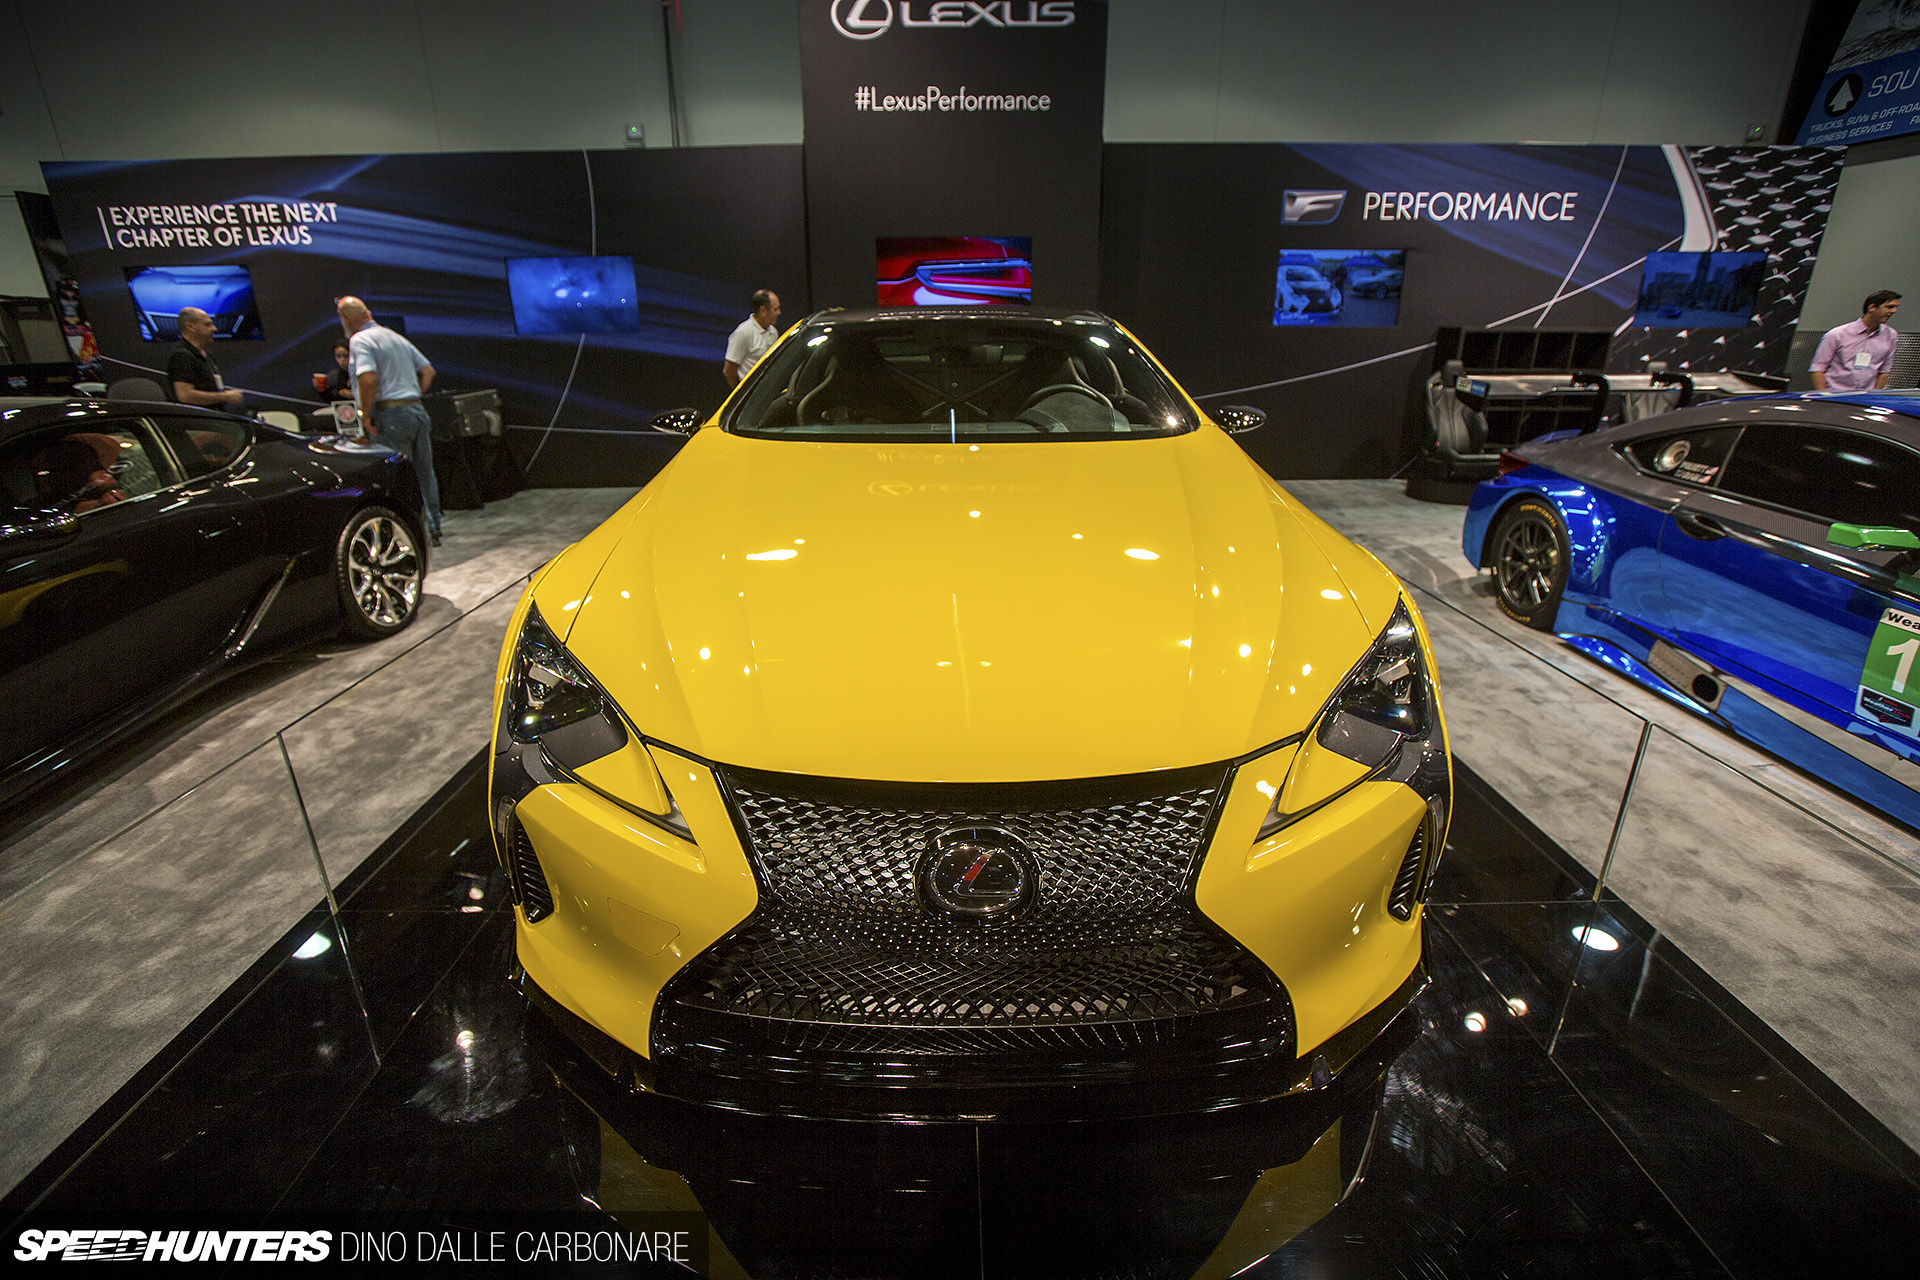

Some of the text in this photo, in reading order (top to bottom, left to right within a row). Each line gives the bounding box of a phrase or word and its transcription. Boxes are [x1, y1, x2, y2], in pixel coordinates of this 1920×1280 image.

[902, 1, 1076, 28] LEXUS
[855, 85, 1051, 112] #LexusPerformance
[1805, 120, 1893, 146] BUSINESS SERVICES
[108, 202, 338, 226] EXPERIENCE THE NEXT
[1362, 192, 1578, 220] PERFORMANCE
[116, 225, 313, 248] CHAPTER OF LEXUS
